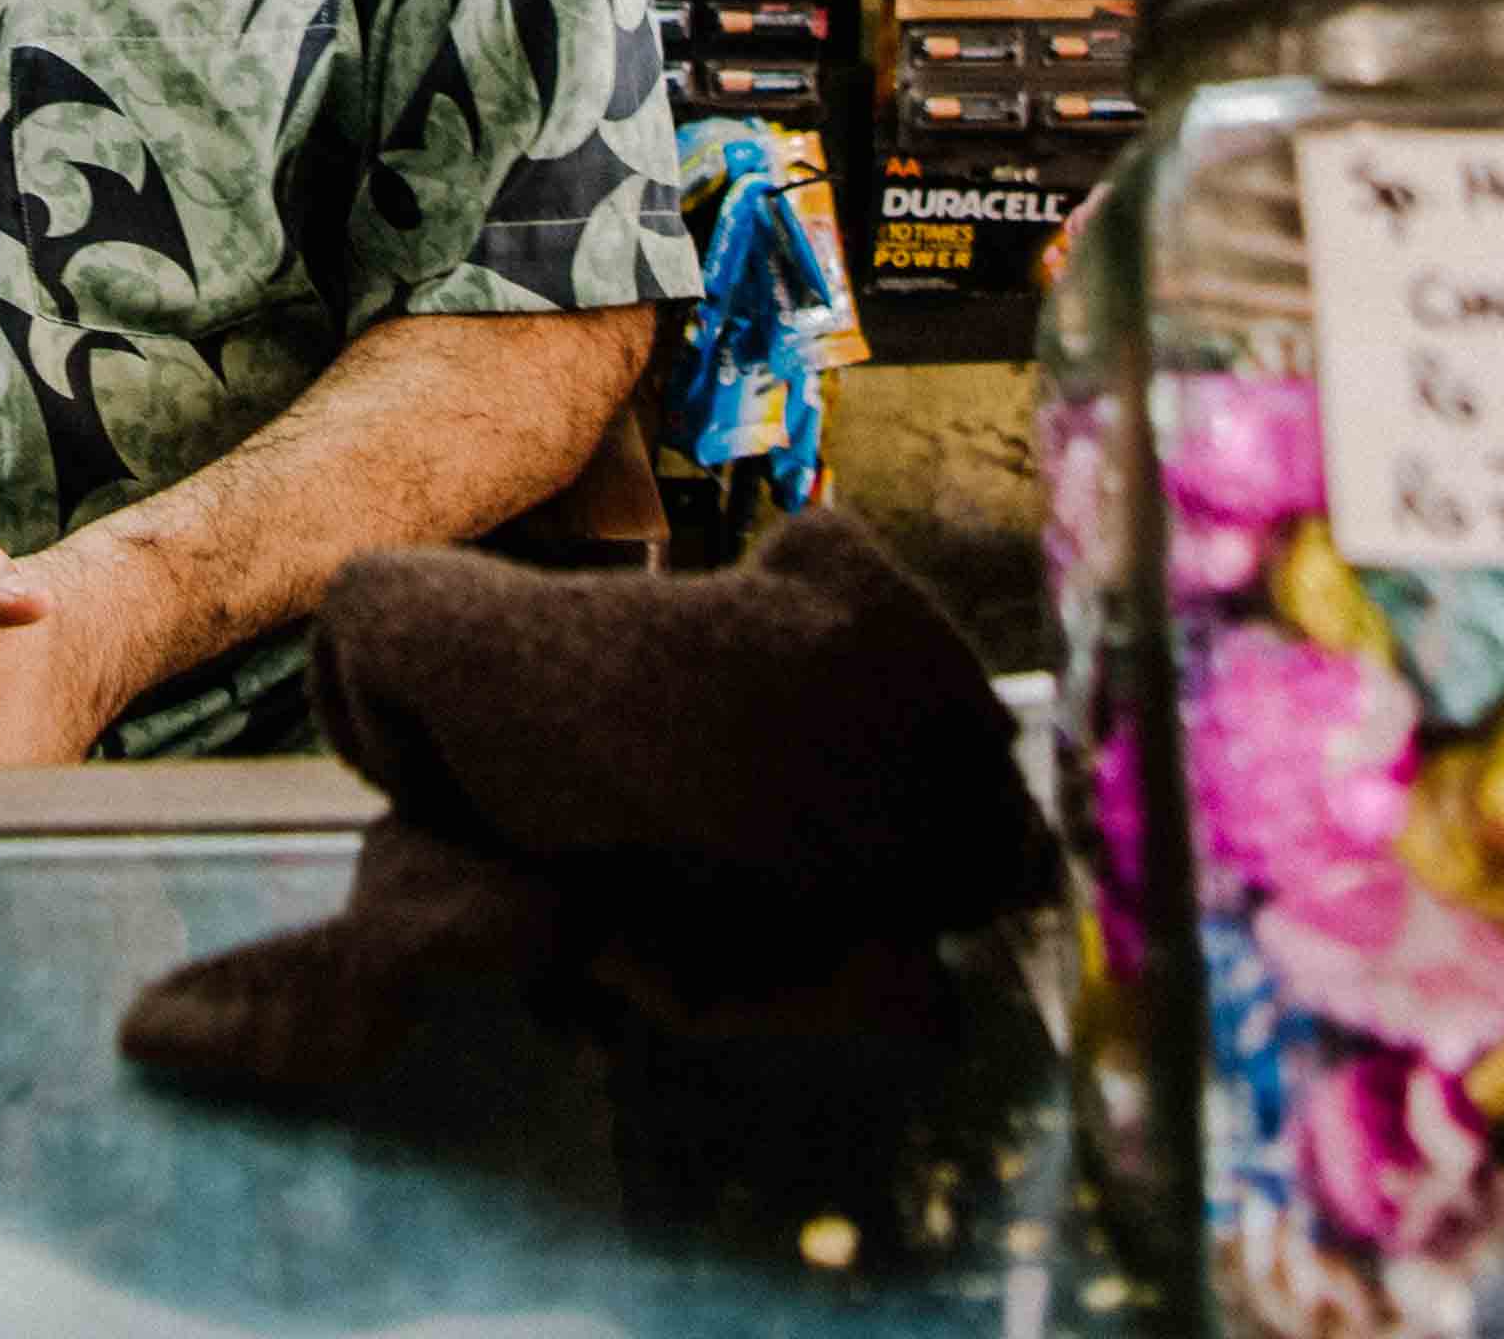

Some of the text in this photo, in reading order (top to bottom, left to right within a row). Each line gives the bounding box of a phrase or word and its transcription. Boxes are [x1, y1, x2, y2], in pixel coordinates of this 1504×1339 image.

[884, 156, 922, 178] AA
[882, 187, 1067, 222] DURACELL
[873, 250, 973, 268] POWER
